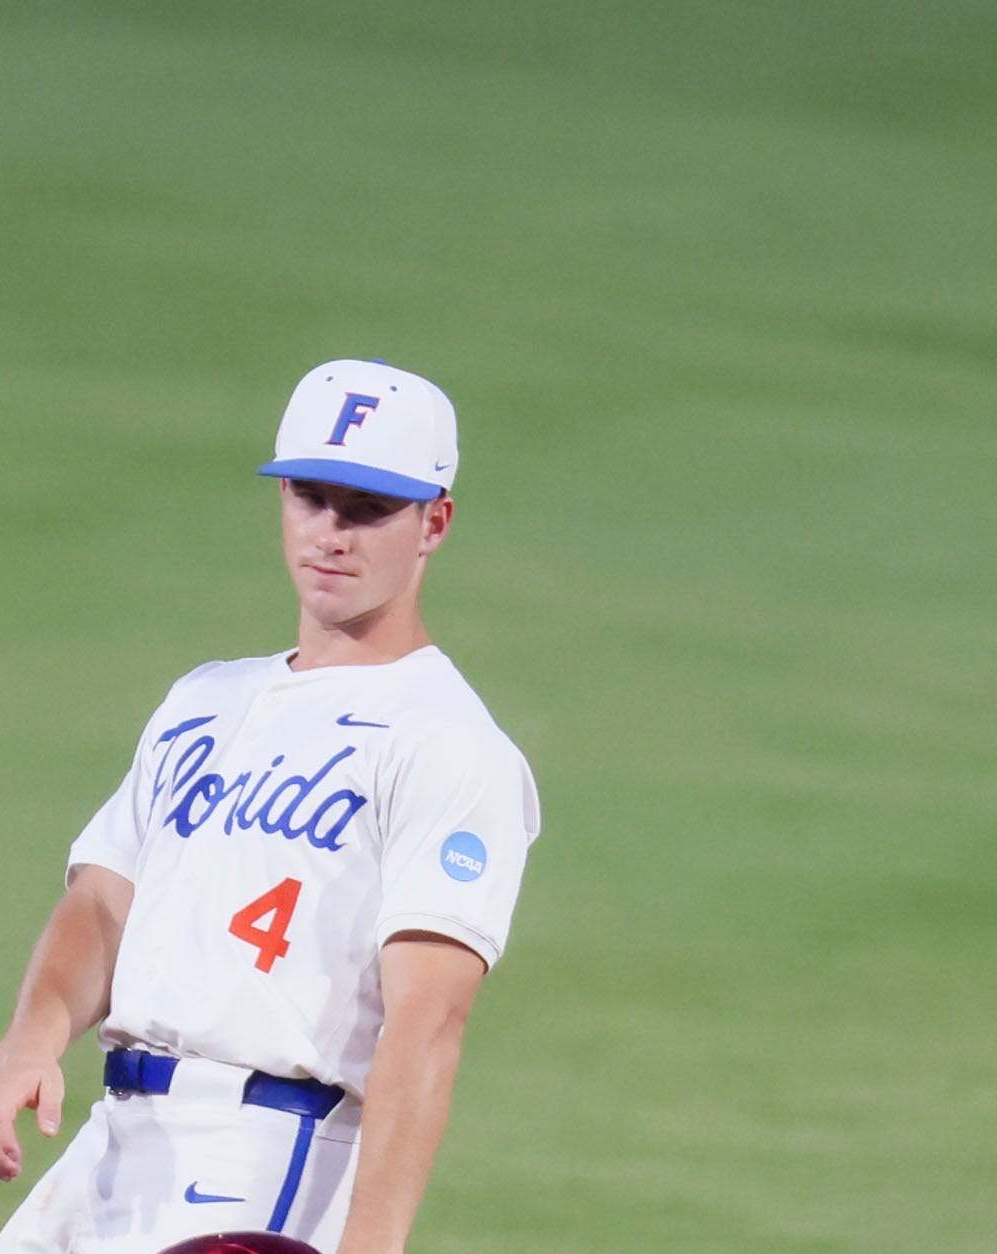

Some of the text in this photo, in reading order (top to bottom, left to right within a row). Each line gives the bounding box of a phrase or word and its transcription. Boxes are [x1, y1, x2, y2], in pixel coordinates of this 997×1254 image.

[324, 392, 380, 446] F
[148, 714, 367, 852] Florida
[445, 849, 483, 874] NCAA
[228, 877, 302, 973] 4
